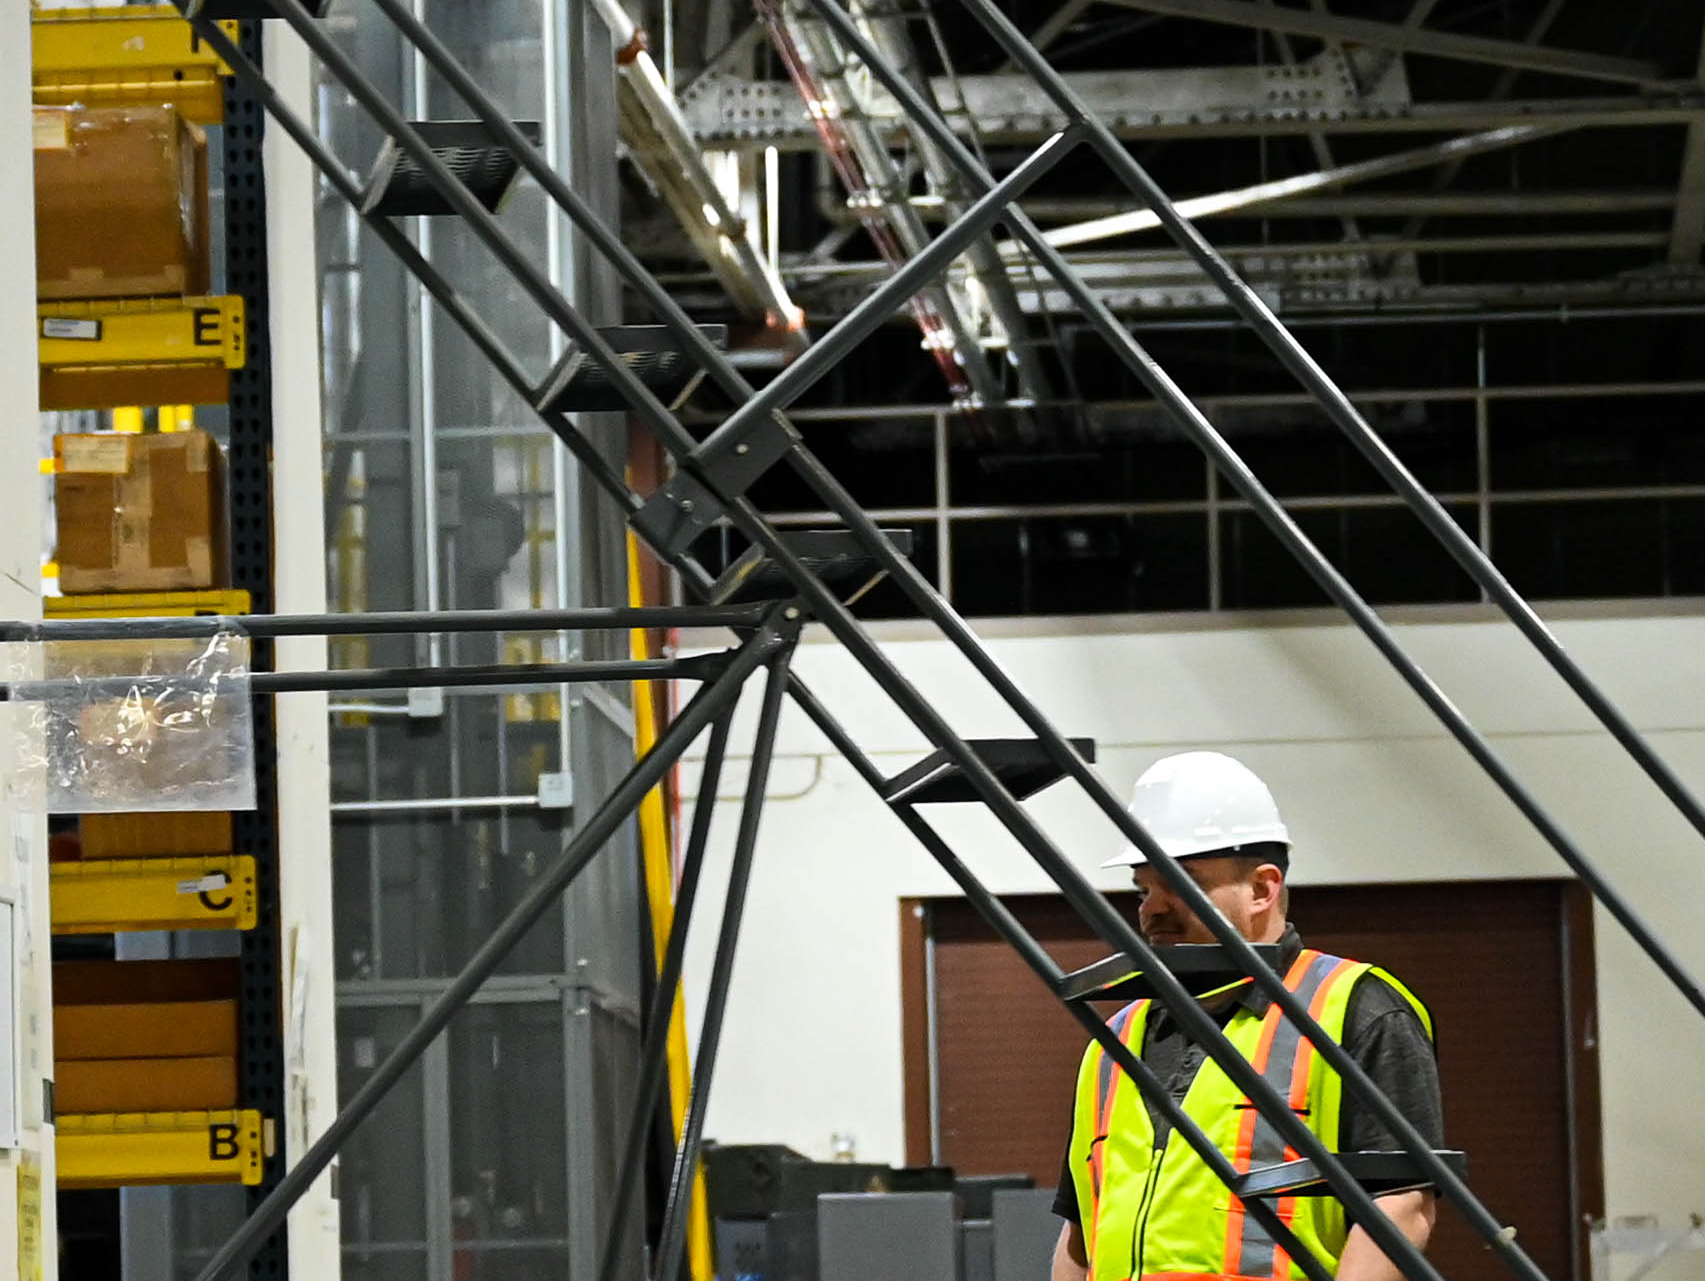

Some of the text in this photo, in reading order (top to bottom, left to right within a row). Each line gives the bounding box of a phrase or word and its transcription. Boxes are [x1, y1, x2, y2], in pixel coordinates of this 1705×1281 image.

[194, 309, 222, 346] E
[199, 870, 233, 911] C
[210, 1124, 239, 1160] B
